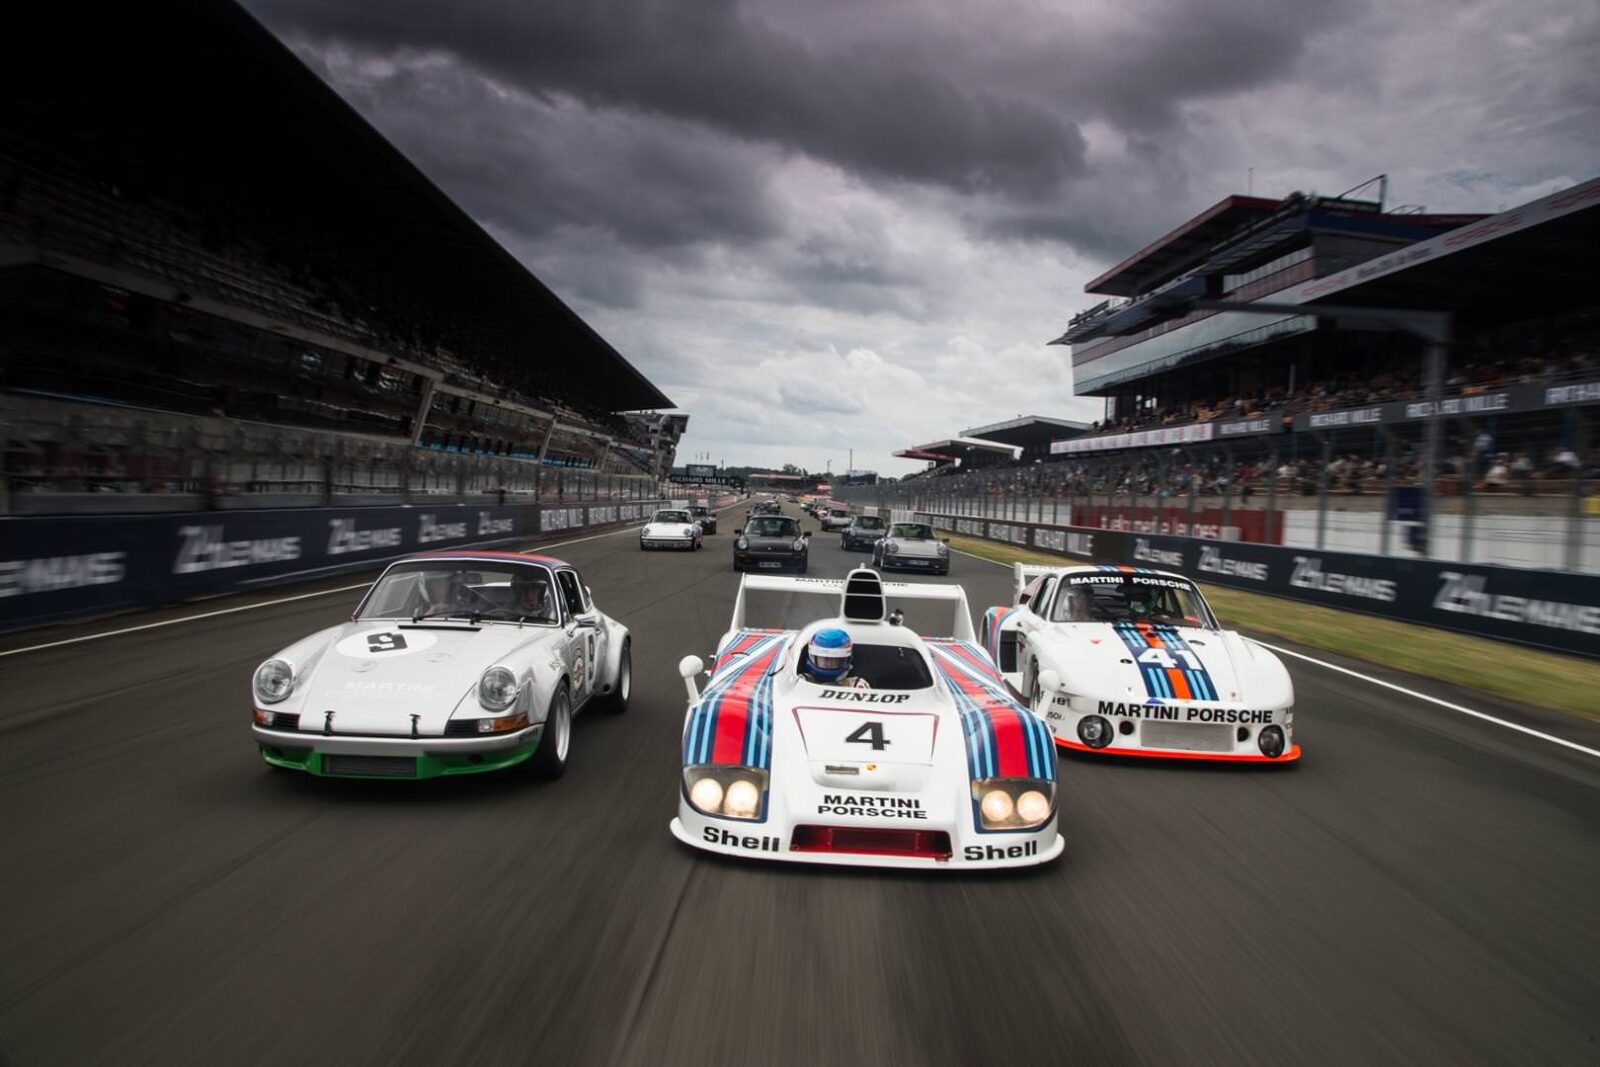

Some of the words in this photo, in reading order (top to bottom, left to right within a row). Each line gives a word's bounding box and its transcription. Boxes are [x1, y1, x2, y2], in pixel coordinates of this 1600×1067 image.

[1070, 576, 1124, 585] MARTINI
[1133, 578, 1192, 591] PORSCHE
[367, 632, 408, 653] 9
[1137, 647, 1203, 671] 41
[819, 689, 910, 703] DUNLOP
[1097, 700, 1180, 721] MARTINI
[1186, 708, 1273, 724] PORSCHE
[845, 721, 890, 751] 4
[817, 805, 928, 819] PORSCHE
[824, 794, 920, 809] MARTINI
[703, 826, 780, 852] Shell
[964, 840, 1038, 862] Shell
